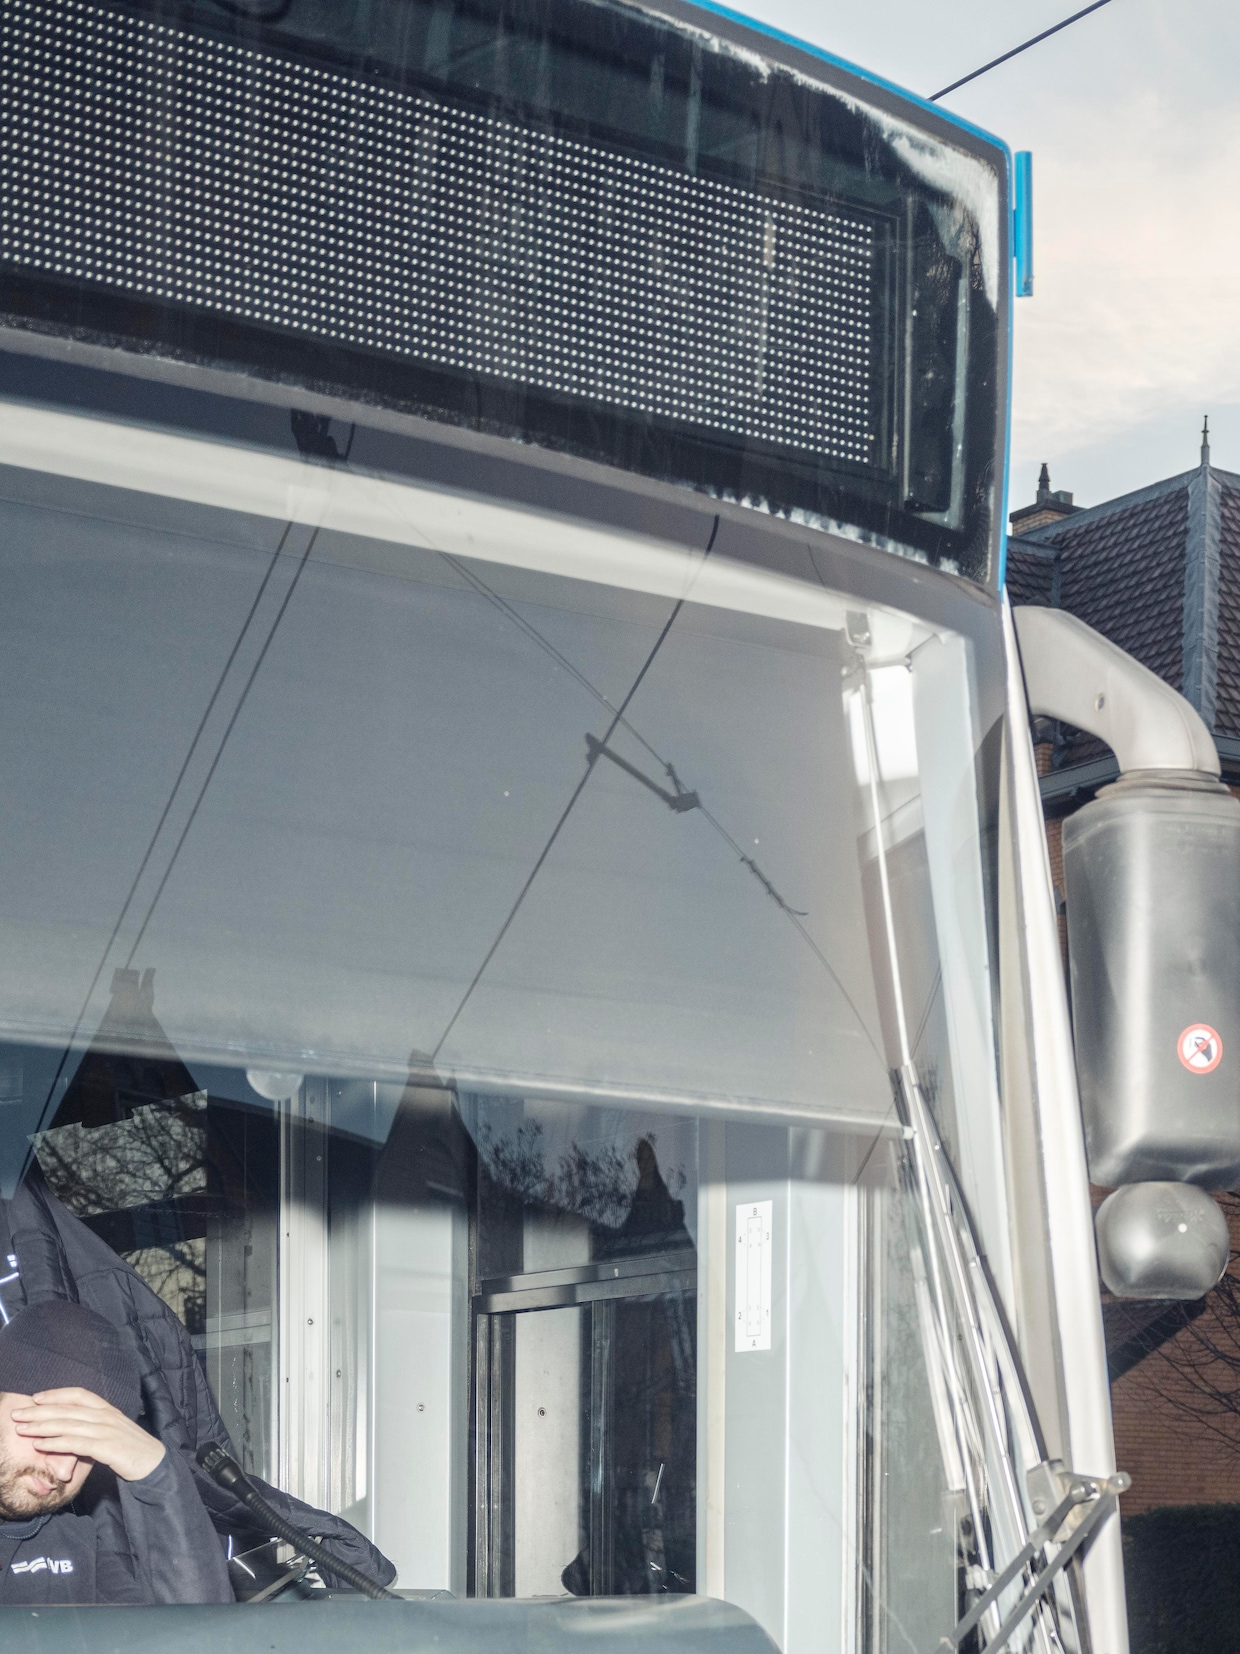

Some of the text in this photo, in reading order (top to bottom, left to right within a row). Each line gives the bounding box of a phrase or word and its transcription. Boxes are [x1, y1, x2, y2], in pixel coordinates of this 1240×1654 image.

[752, 1207, 758, 1216] B
[738, 1235, 742, 1243] 4
[738, 1311, 742, 1320] 2
[751, 1339, 757, 1348] A
[46, 1557, 73, 1574] VB
